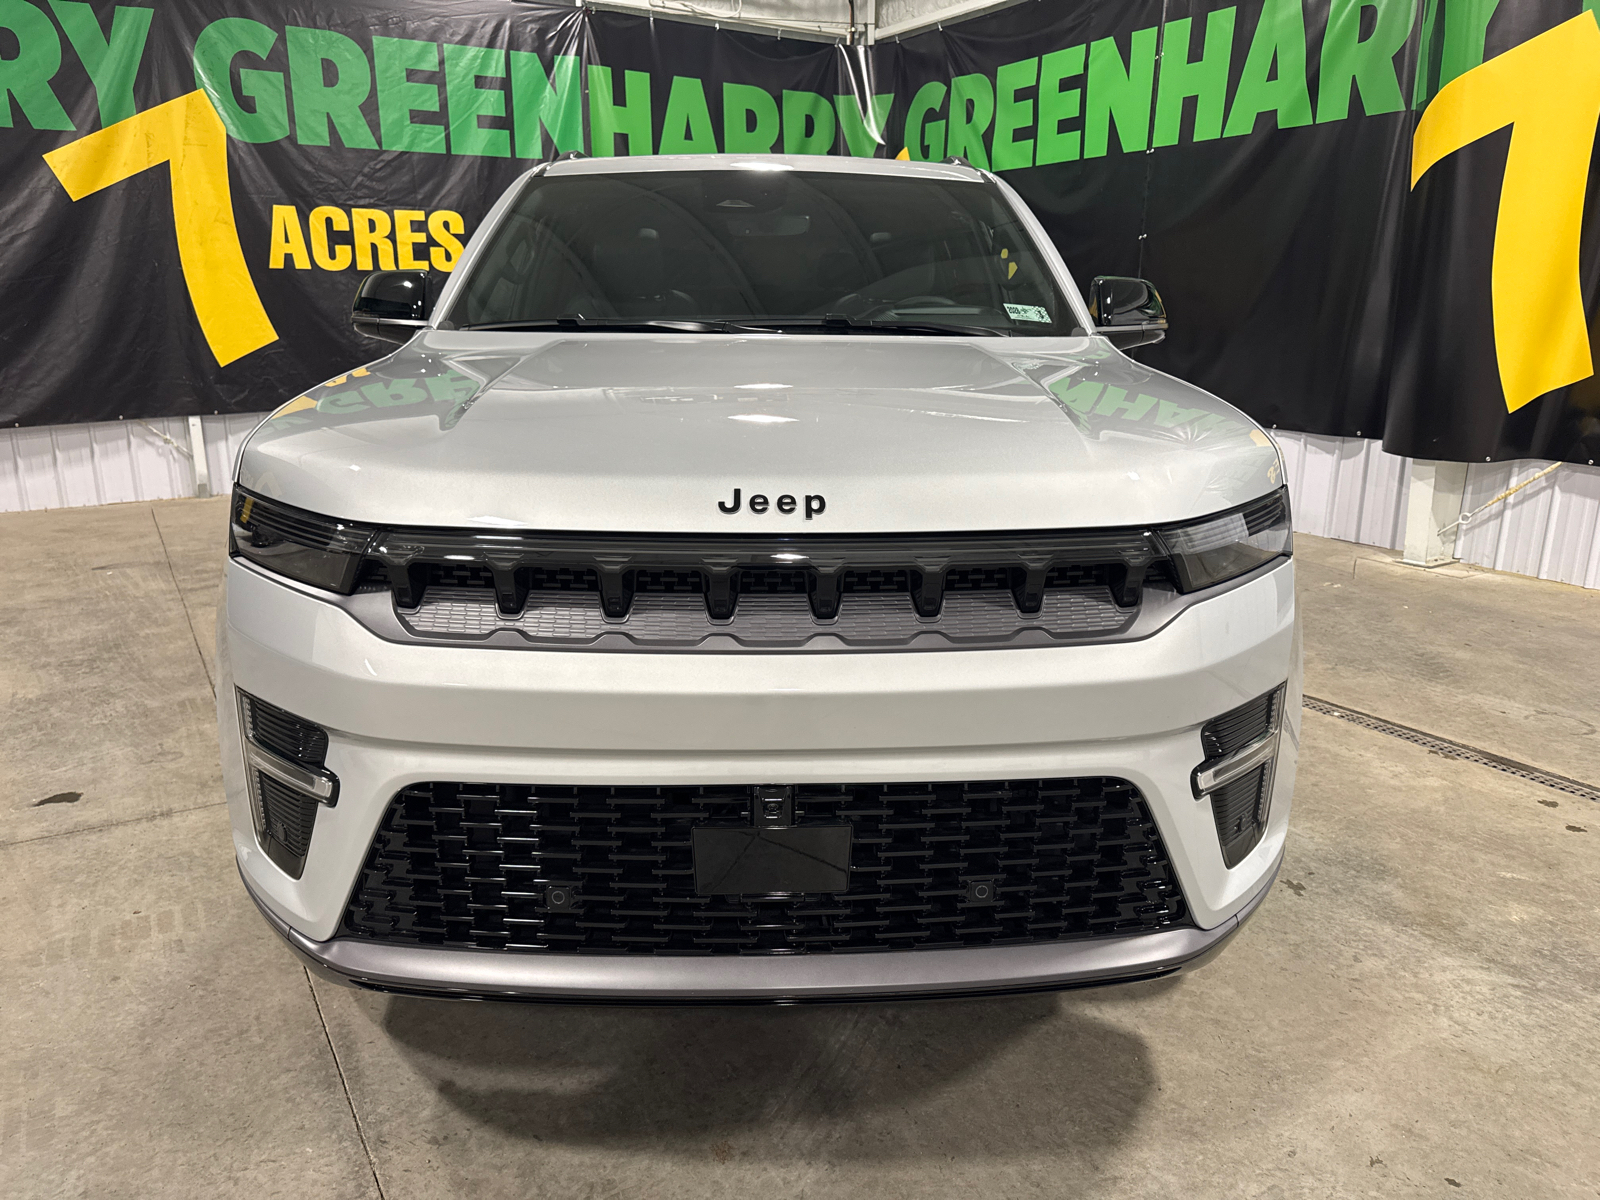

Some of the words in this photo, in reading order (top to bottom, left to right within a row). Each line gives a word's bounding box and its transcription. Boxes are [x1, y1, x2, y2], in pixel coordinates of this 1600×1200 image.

[43, 88, 279, 367] 7
[269, 205, 466, 272] ACRES
[1411, 9, 1600, 414] 7
[718, 488, 826, 520] Jeep
